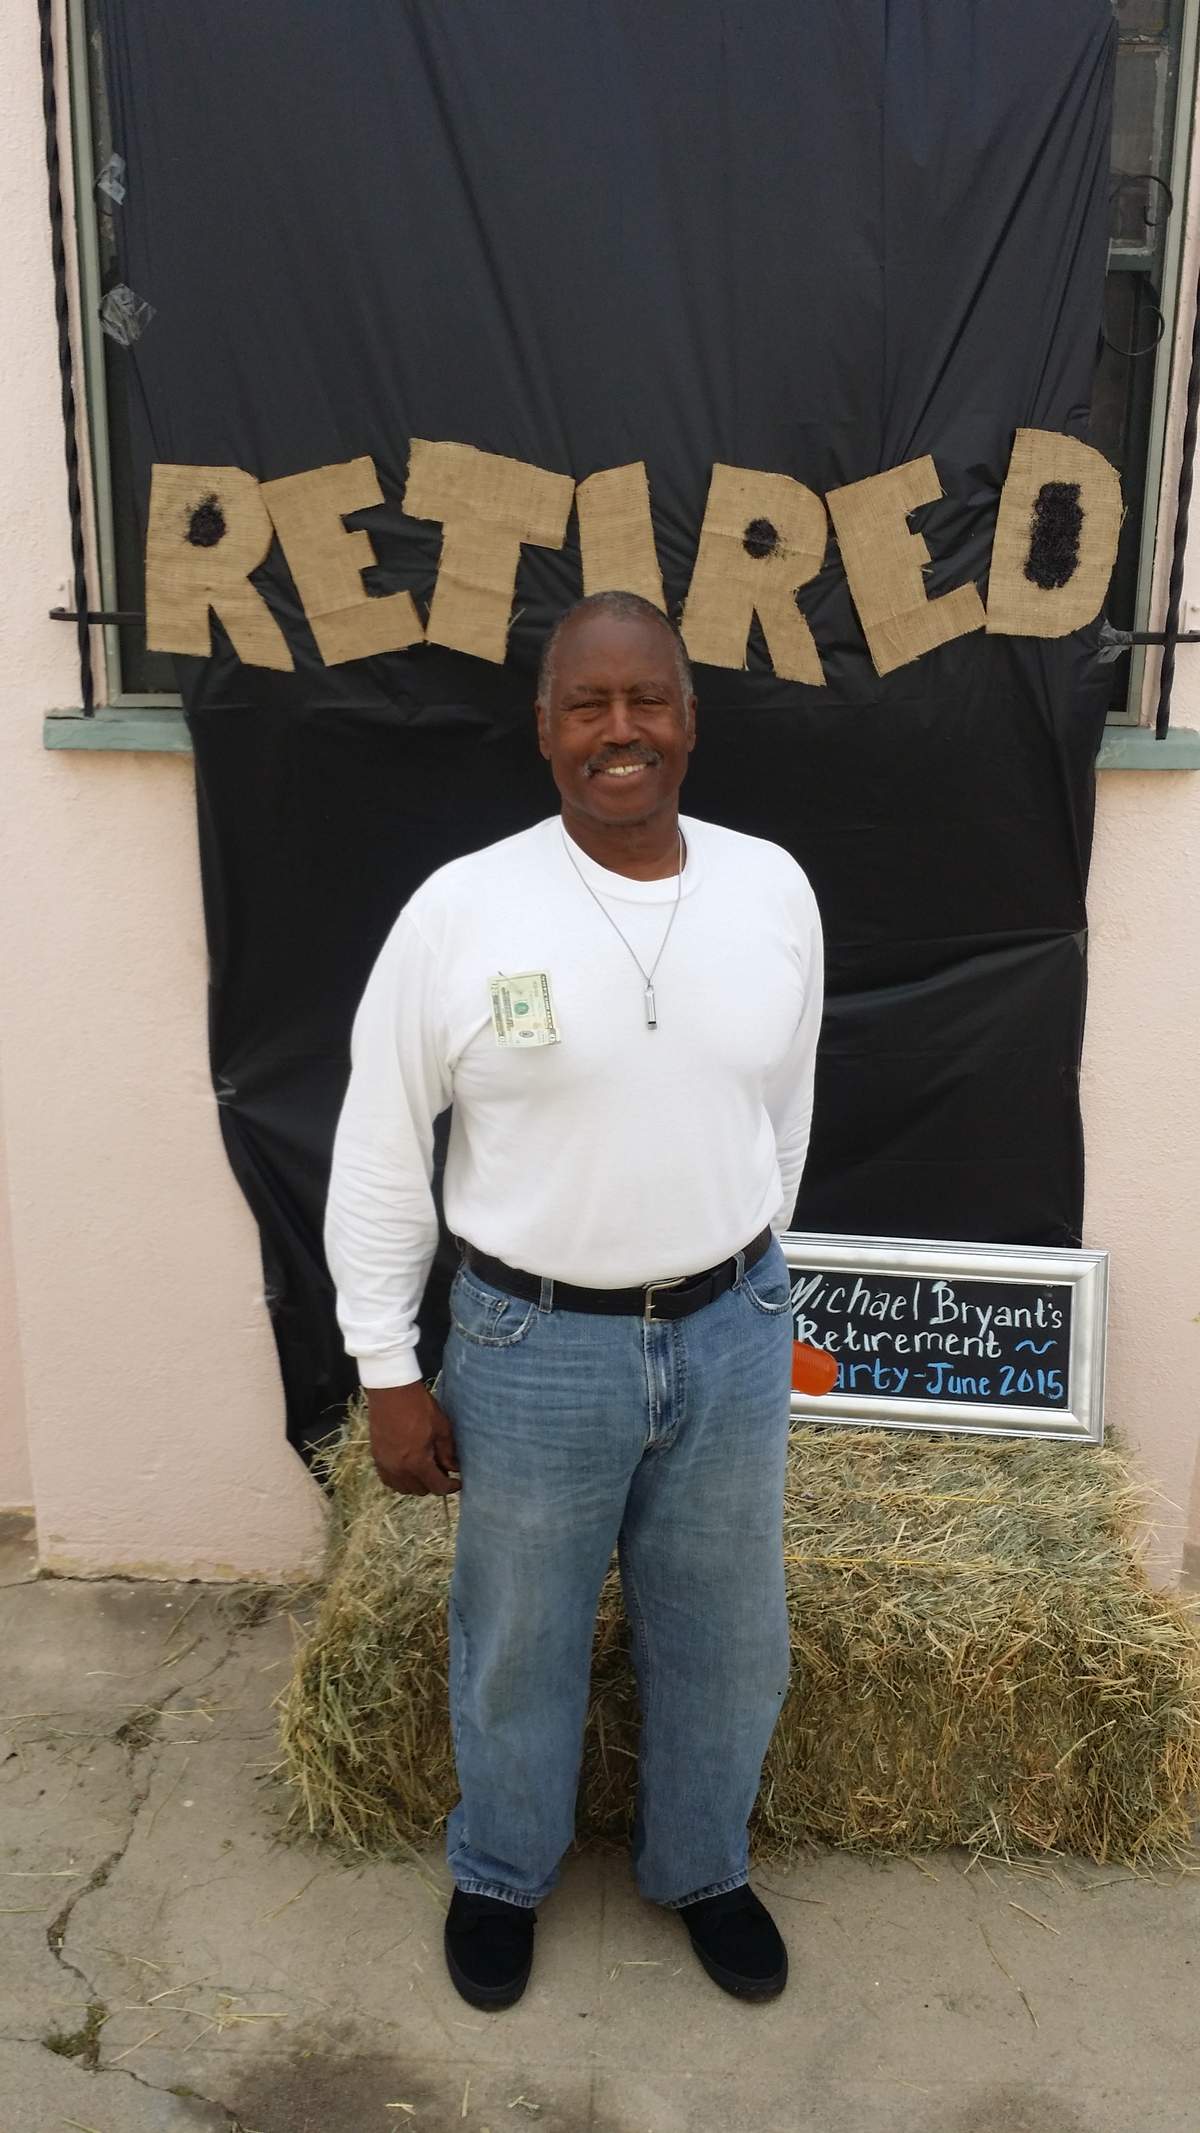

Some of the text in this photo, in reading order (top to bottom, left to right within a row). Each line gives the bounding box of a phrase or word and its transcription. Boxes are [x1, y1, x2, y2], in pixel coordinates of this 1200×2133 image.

[145, 429, 1125, 686] RETIRED
[789, 1274, 1063, 1338] Michael Bryant's
[796, 1314, 1002, 1358] Retirement
[834, 1358, 1064, 1400] arty-June 2015
